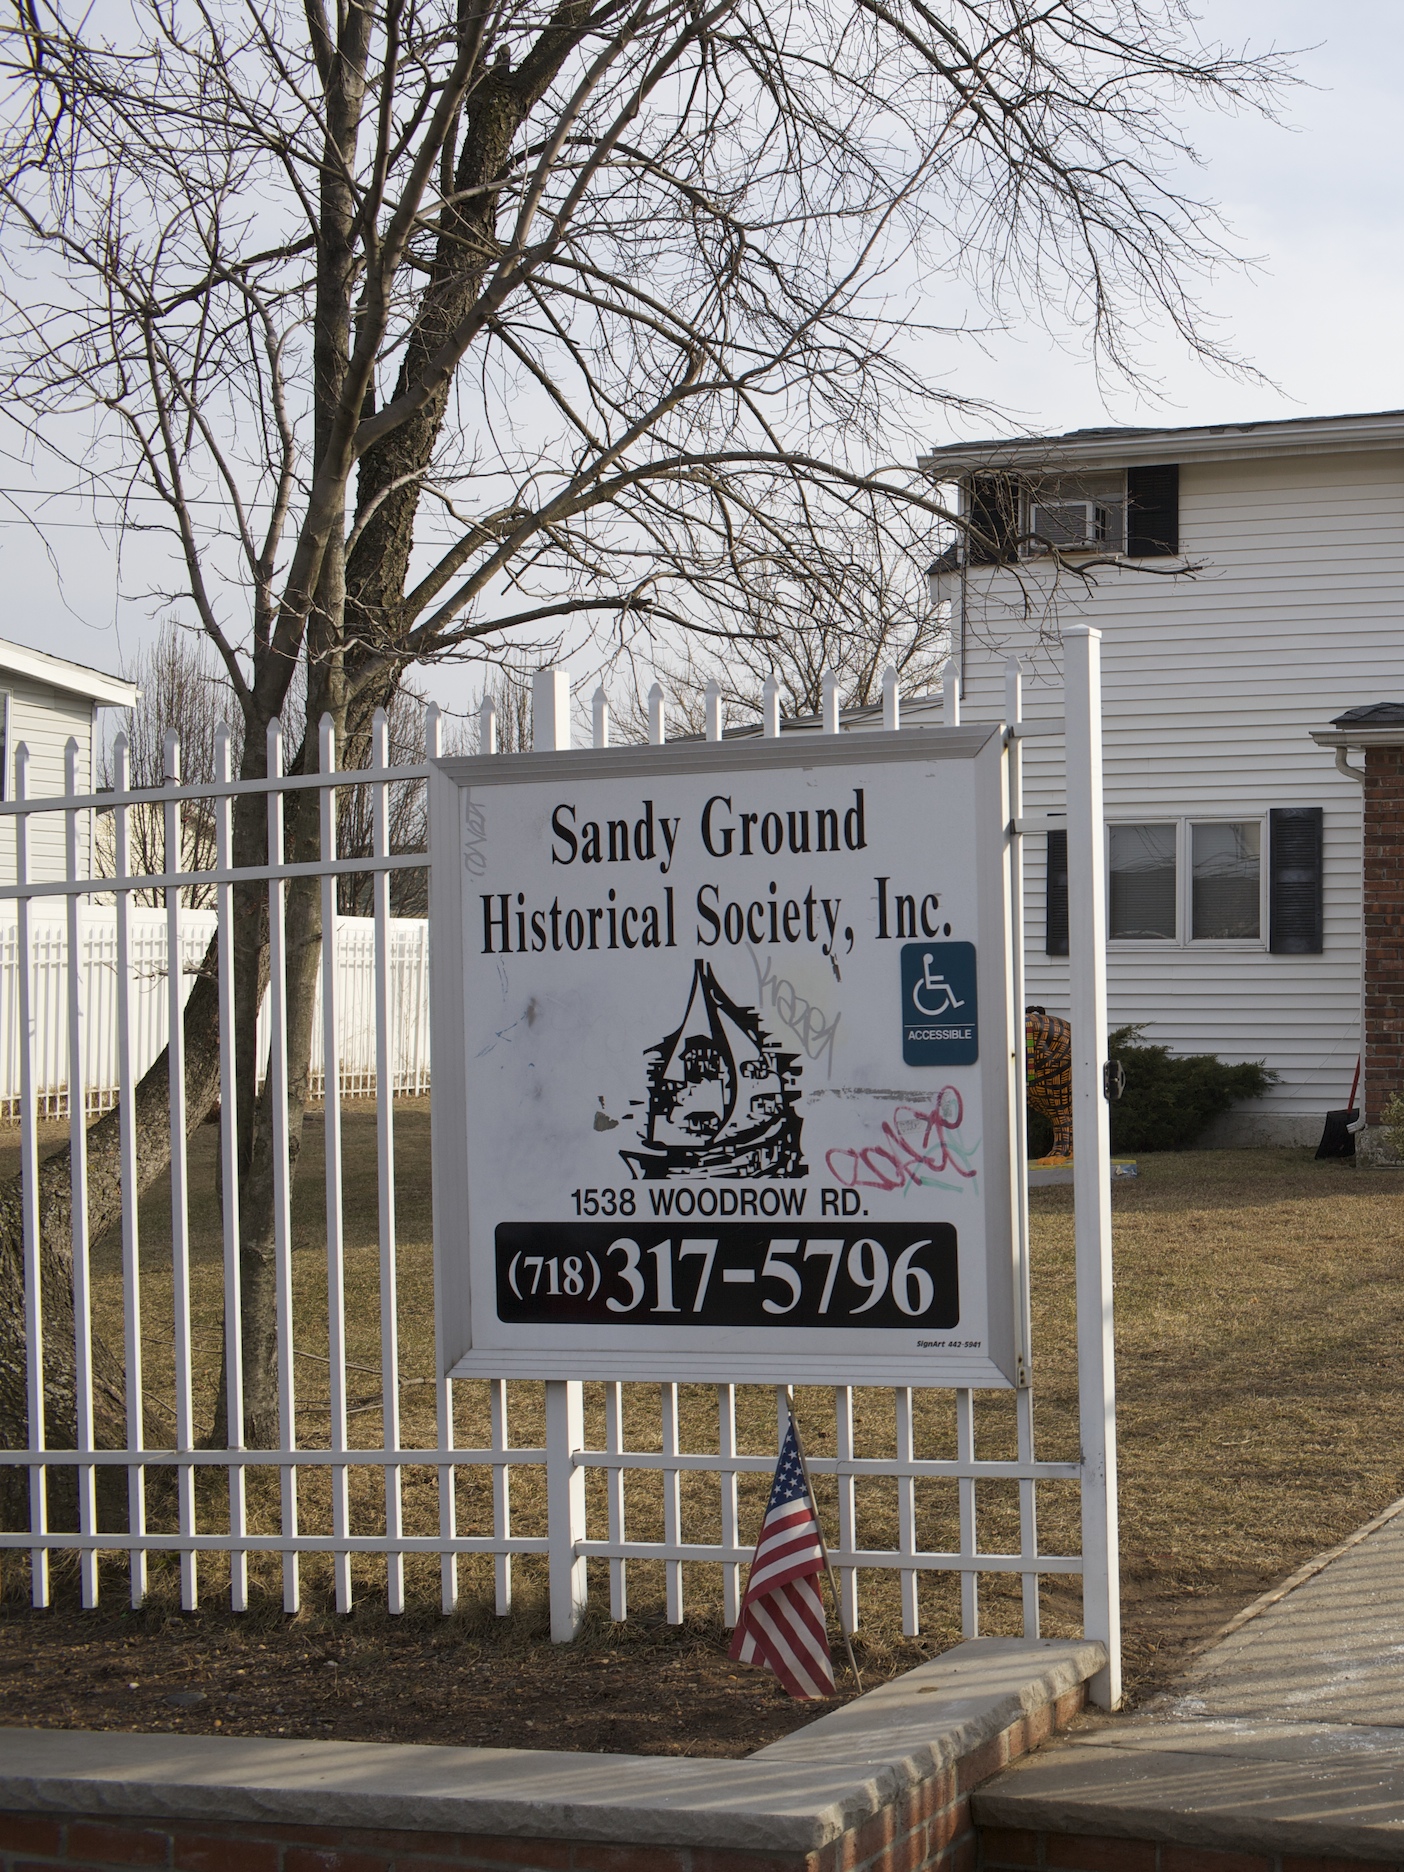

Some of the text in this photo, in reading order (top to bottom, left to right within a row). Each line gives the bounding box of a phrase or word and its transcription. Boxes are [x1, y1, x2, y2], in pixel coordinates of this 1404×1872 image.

[551, 800, 681, 874] Sandy
[701, 788, 868, 857] Ground
[479, 876, 952, 956] Historical Society, Inc.
[908, 1029, 972, 1040] ACCESSIBLE
[570, 1188, 869, 1216] 1538 WOODROW RD.
[916, 1340, 945, 1348] SignArt
